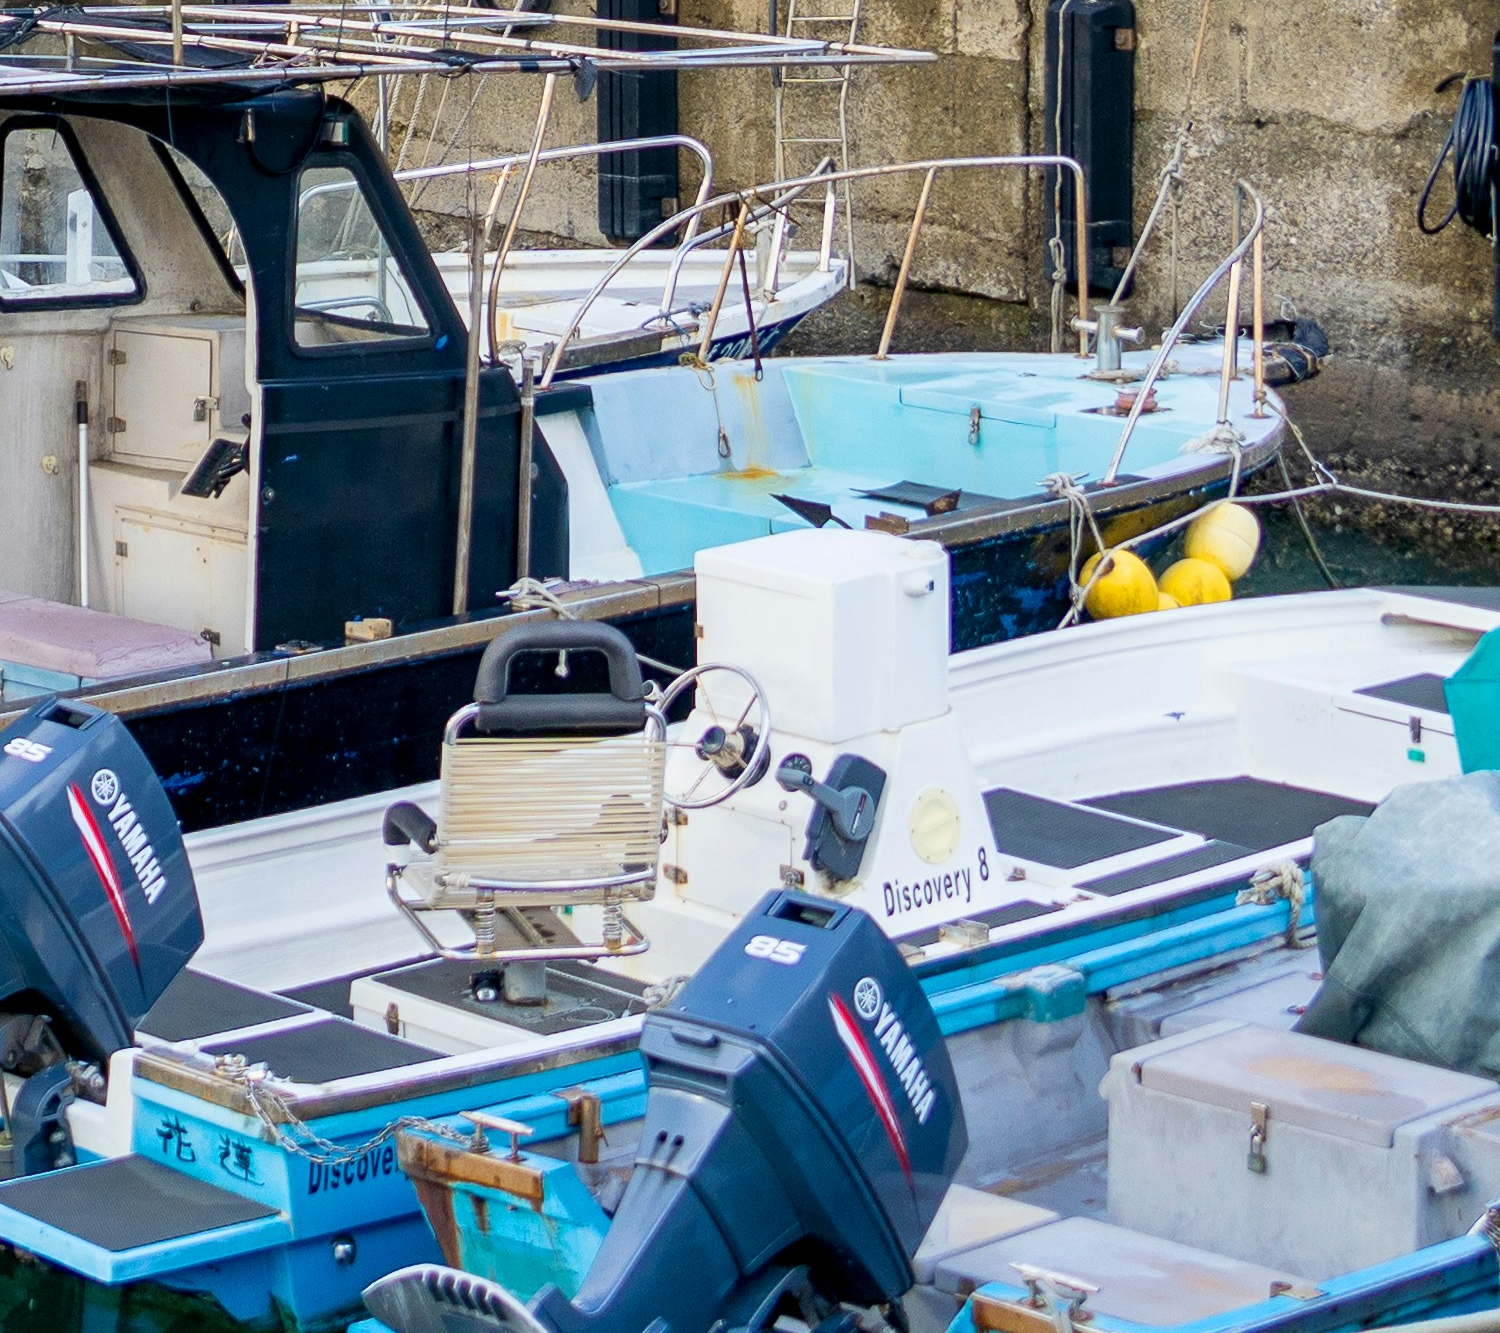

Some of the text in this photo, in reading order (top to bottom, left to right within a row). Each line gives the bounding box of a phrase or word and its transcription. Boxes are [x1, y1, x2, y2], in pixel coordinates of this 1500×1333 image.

[3, 737, 54, 763] 85
[107, 792, 168, 905] YAMAHA
[882, 845, 990, 917] Discovery 8
[743, 934, 809, 965] 85
[873, 1001, 937, 1125] YAMAHA
[155, 1112, 266, 1187] 花蓮
